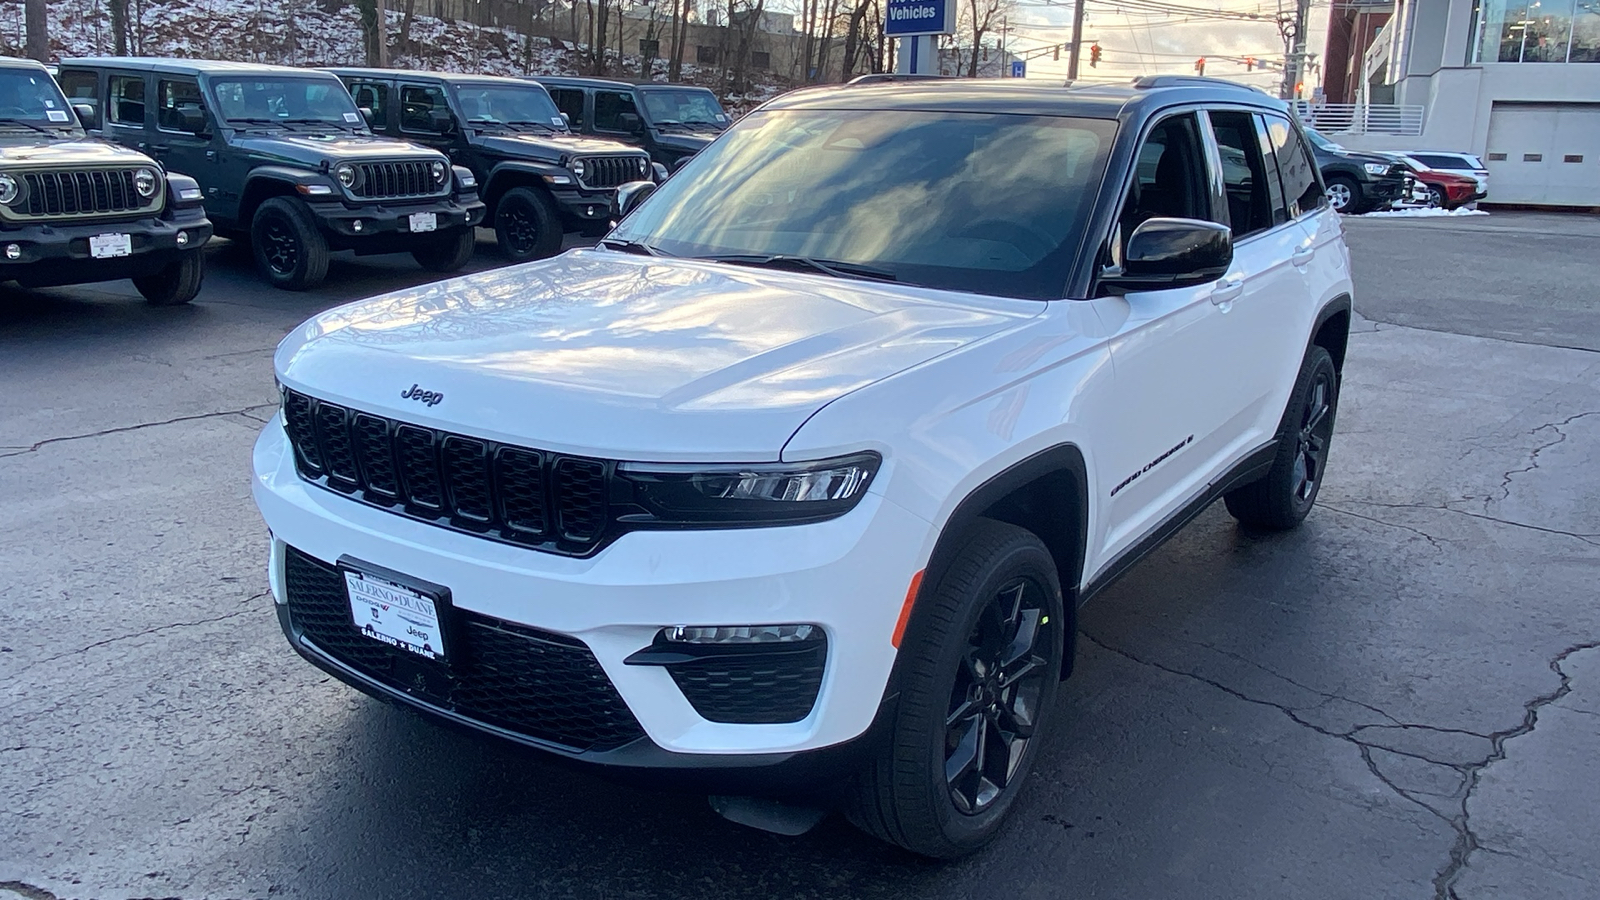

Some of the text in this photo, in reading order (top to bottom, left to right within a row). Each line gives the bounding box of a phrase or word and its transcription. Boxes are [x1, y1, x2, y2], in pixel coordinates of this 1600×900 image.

[890, 5, 936, 21] Vehicles
[401, 384, 444, 407] Jeep
[1110, 470, 1141, 497] GRAND
[348, 579, 394, 602] SALERNO
[399, 597, 436, 617] DUANE
[361, 628, 436, 660] SALERNO DUANE
[406, 626, 429, 641] Jeep
